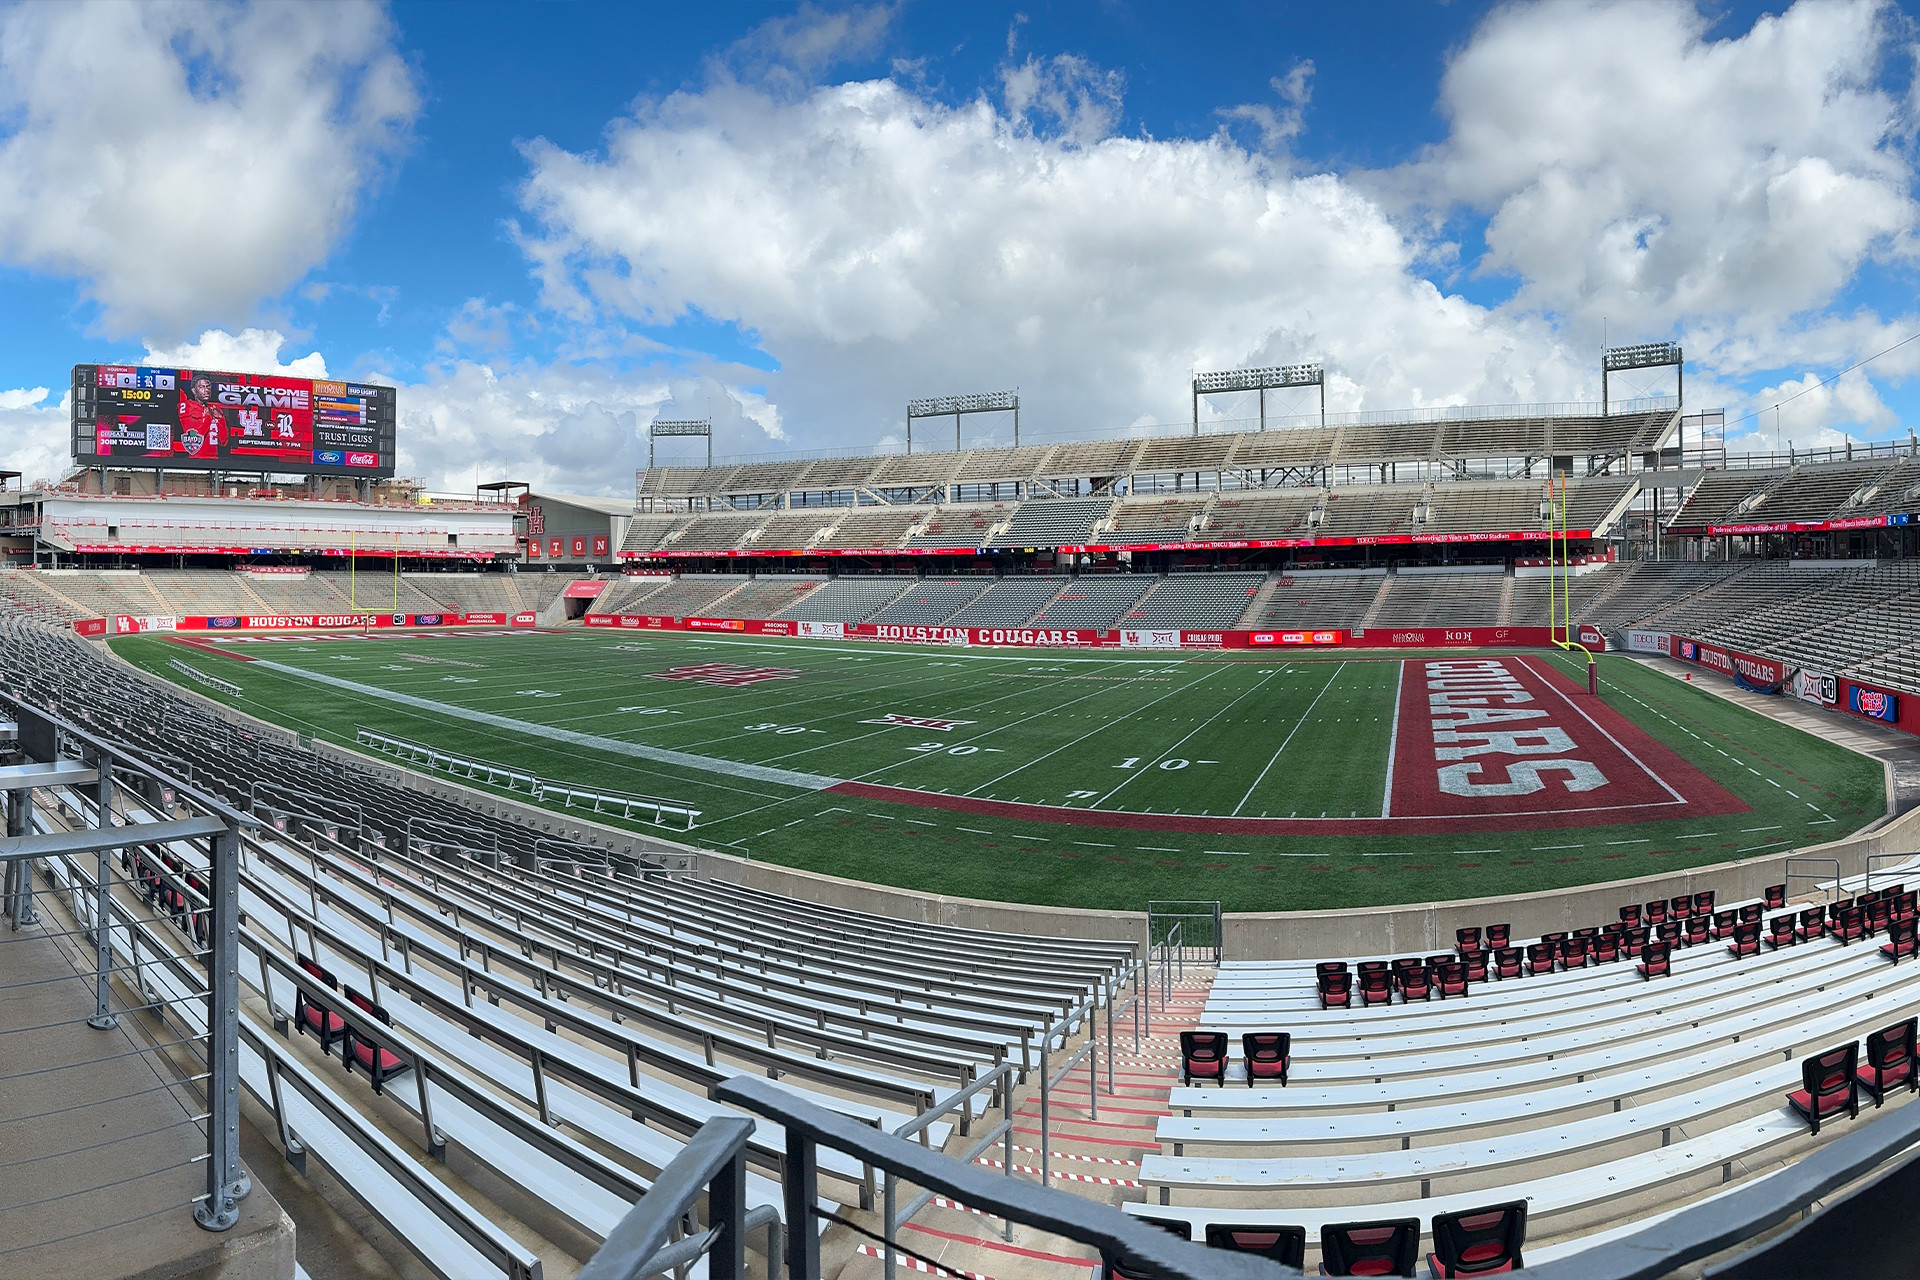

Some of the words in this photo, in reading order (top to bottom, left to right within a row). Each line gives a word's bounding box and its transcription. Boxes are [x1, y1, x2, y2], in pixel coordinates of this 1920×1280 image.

[121, 389, 151, 401] 15:00
[218, 384, 260, 394] NEXT
[263, 387, 309, 397] HOME
[217, 391, 309, 410] GAME
[238, 409, 263, 437] UH
[100, 438, 117, 446] JOIN
[118, 439, 146, 448] TODAY!
[319, 432, 348, 442] TRUST
[351, 434, 373, 444] GUSS
[1779, 523, 1788, 531] UH
[1158, 543, 1185, 551] Celebrating
[248, 616, 314, 627] HOUSTON
[318, 616, 377, 627] COUGARS
[876, 625, 970, 644] HOUSTON
[978, 629, 1079, 644] COUGARS
[1186, 633, 1207, 642] COUGAR
[1207, 633, 1223, 642] PRIDE
[1495, 630, 1509, 639] GF
[1632, 634, 1655, 644] TDECU
[1700, 648, 1733, 671] HOUSTON
[1734, 658, 1774, 683] COUGARS
[1822, 679, 1834, 699] 40
[1861, 689, 1883, 703] Jersey
[743, 722, 806, 735] 30
[1424, 660, 1611, 798] COUGARS
[904, 741, 980, 756] 20
[1111, 757, 1190, 771] 10
